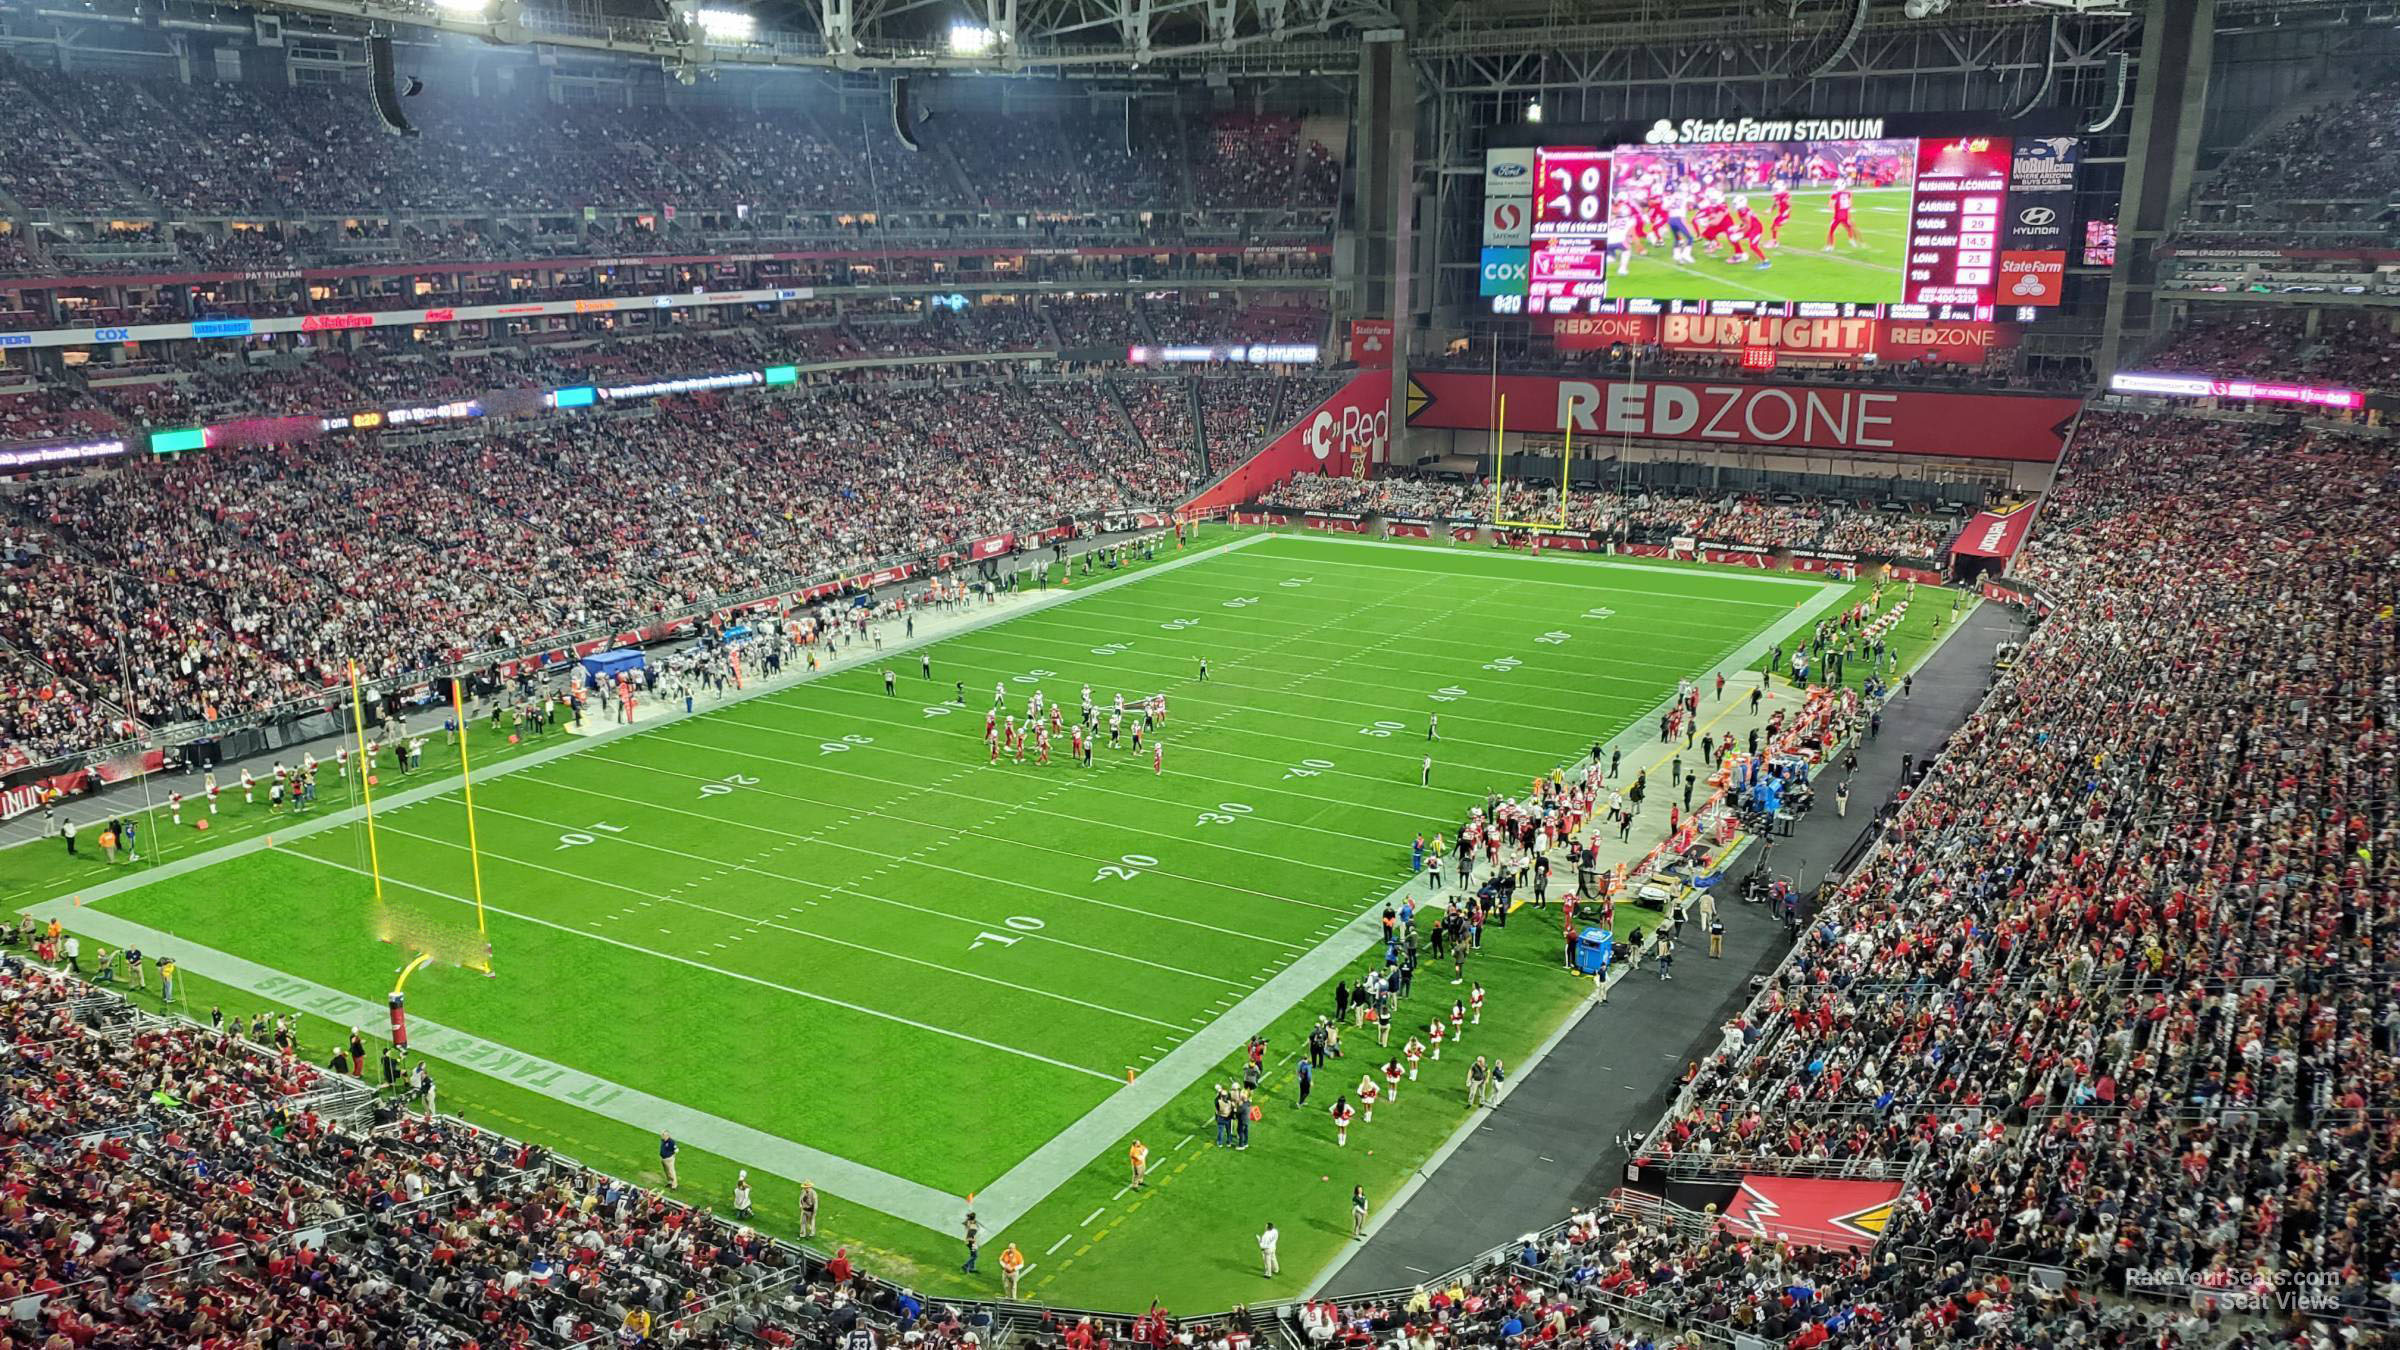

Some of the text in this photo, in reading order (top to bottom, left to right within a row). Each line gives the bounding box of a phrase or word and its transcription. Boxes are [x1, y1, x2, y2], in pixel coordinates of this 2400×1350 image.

[1794, 118, 1883, 140] STADIUM
[2013, 227, 2060, 235] HYUNDAI
[246, 271, 262, 280] PAT
[264, 270, 302, 279] TILLMAN
[1485, 264, 1526, 280] COX
[95, 328, 129, 341] COX
[1554, 319, 1641, 336] REDZONE
[1664, 315, 1862, 348] BUD LIGHT
[1890, 327, 1995, 346] REDZONE
[1557, 381, 1898, 447] REDZONE
[1341, 398, 1389, 453] Red
[42, 448, 79, 461] favorite
[1556, 530, 1591, 538] CARDINALS
[1730, 545, 1768, 553] CARDINALS
[1817, 552, 1857, 561] CARDINALS
[1280, 577, 1311, 588] 10
[1222, 597, 1258, 608] 20
[1581, 608, 1616, 620] 10
[1160, 618, 1198, 630] 30
[1534, 631, 1572, 645] 20
[1483, 658, 1524, 672] 30
[1012, 669, 1057, 684] 50
[1428, 687, 1469, 703] 40
[1359, 721, 1406, 738] 50
[820, 734, 875, 753] 30
[1288, 758, 1335, 779] 40
[700, 773, 761, 796] 20
[1199, 802, 1254, 825] 30
[559, 821, 629, 846] 10
[1098, 853, 1159, 881] 20
[978, 915, 1046, 948] 10
[253, 976, 311, 998] US
[303, 996, 362, 1015] OF
[436, 1038, 567, 1088] TAKES
[565, 1083, 624, 1107] IT
[1310, 1311, 1316, 1322] 9
[1138, 1328, 1145, 1340] 3
[852, 1338, 869, 1350] 33
